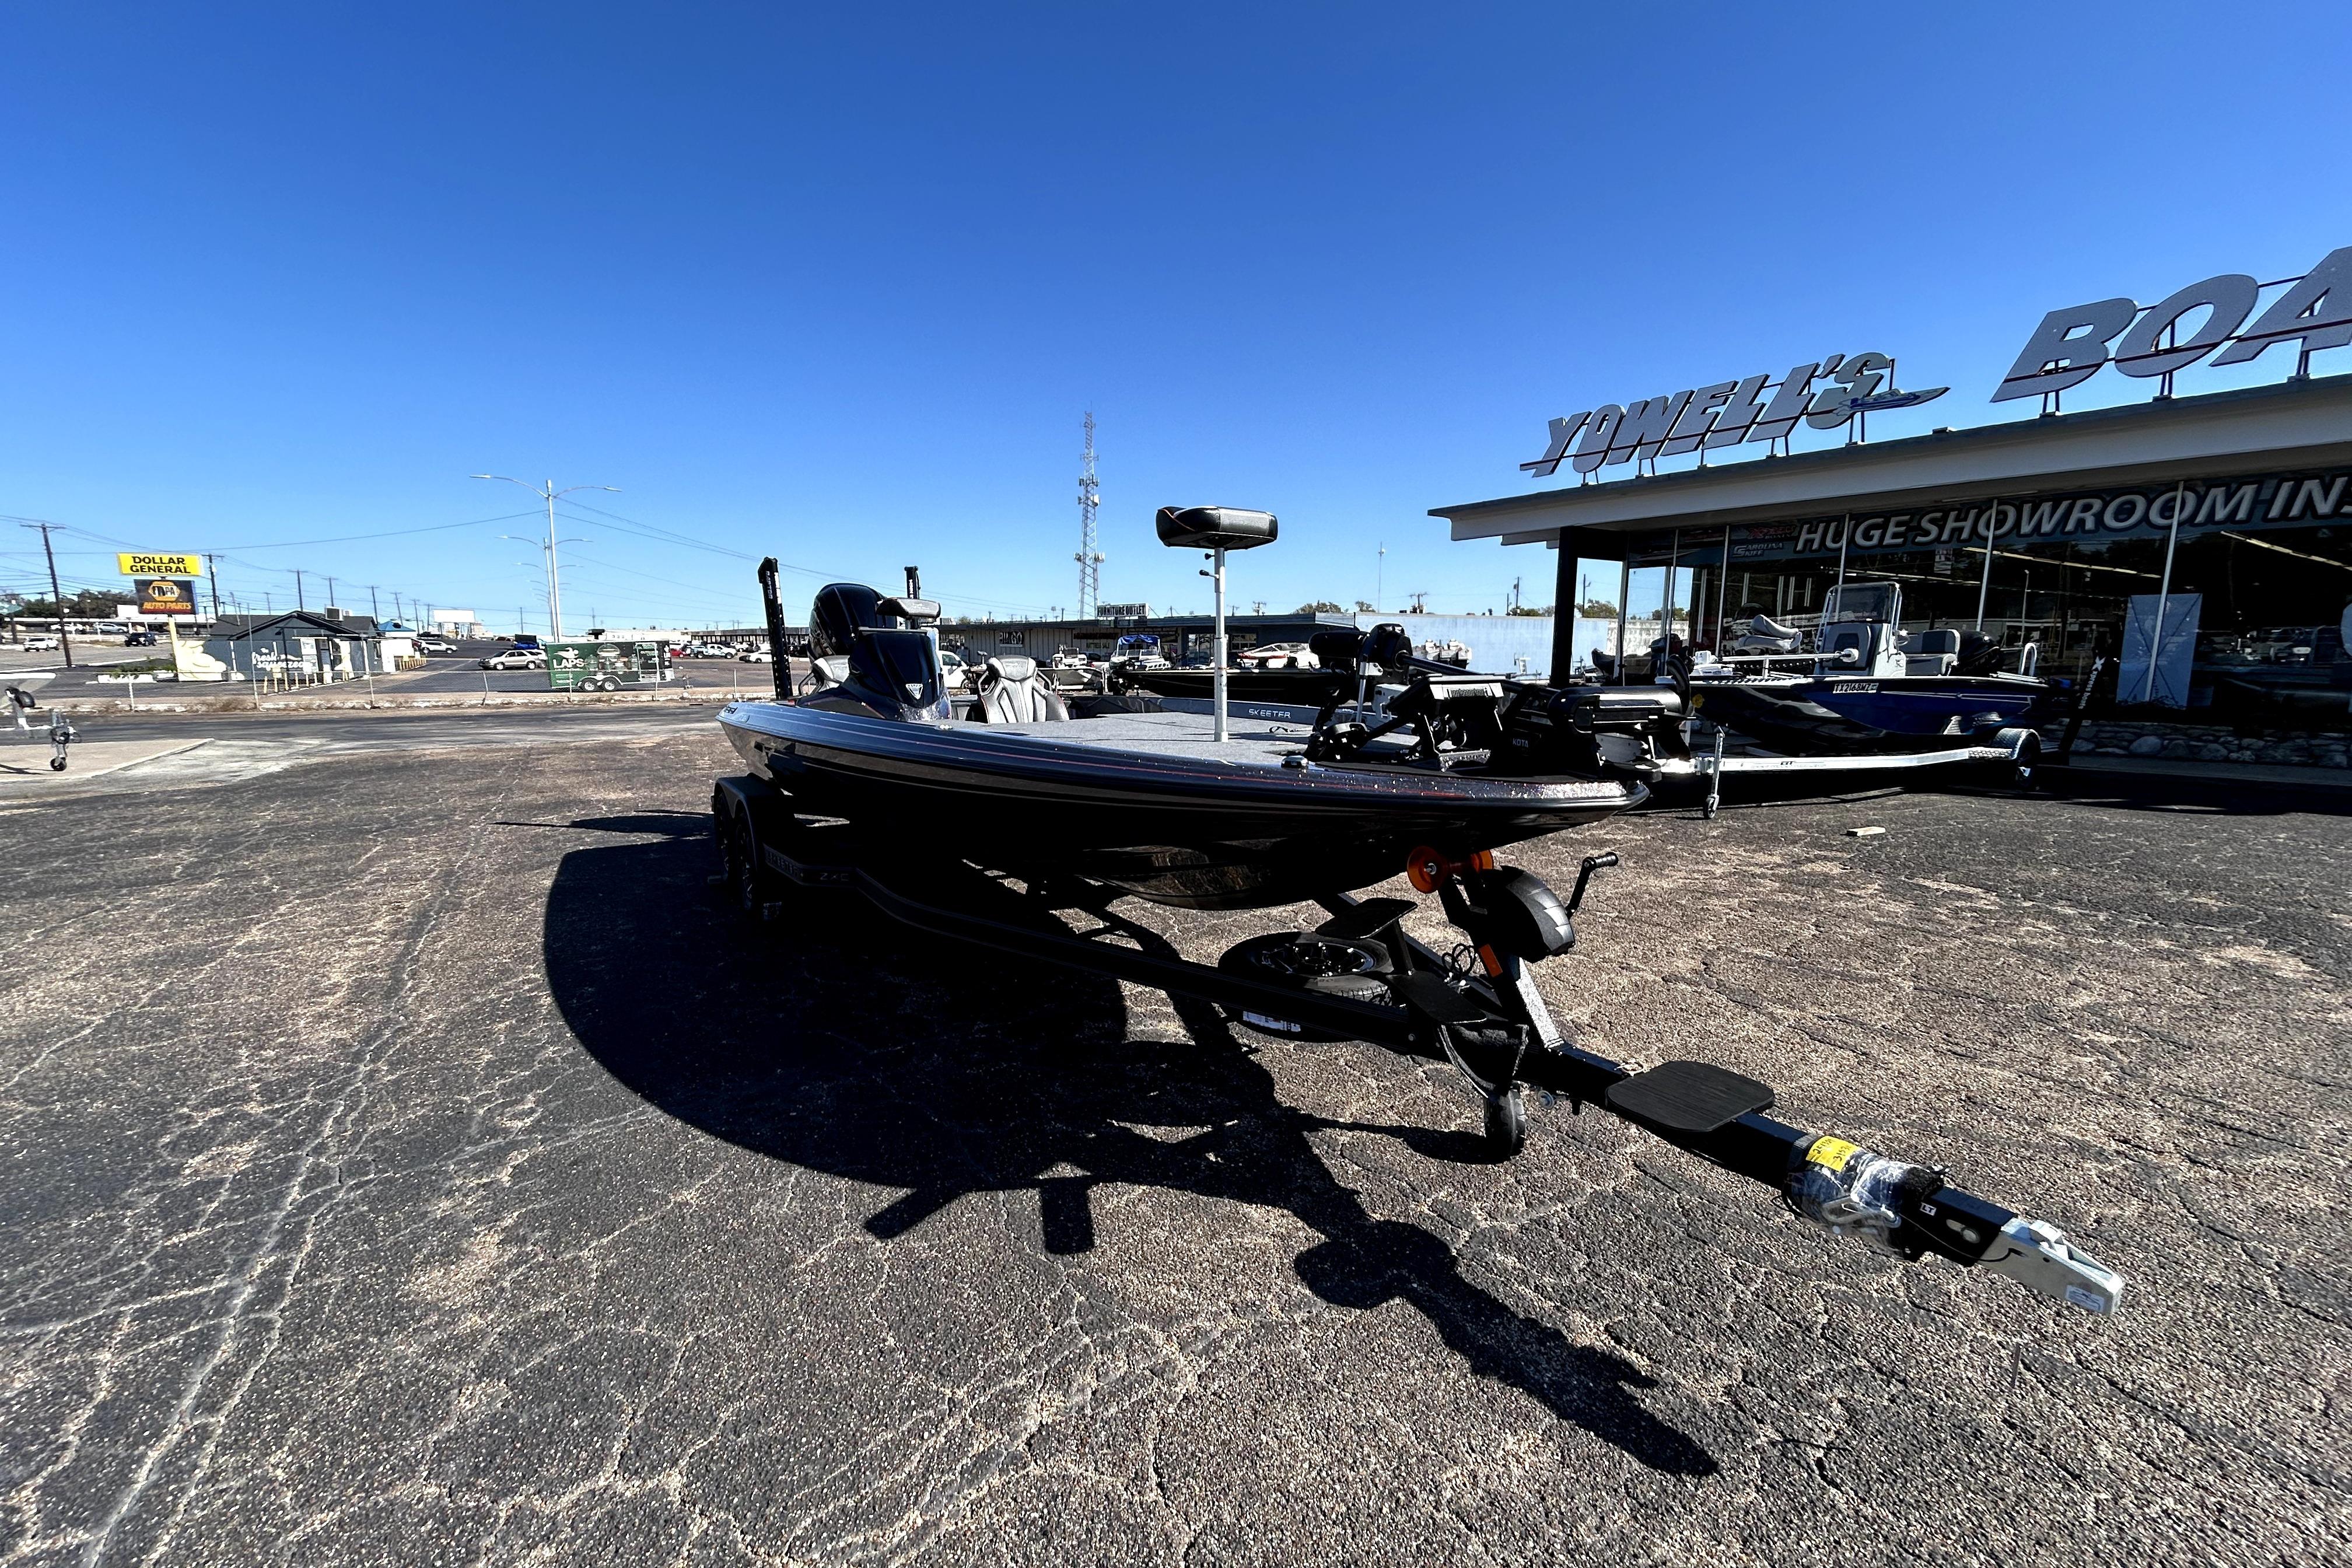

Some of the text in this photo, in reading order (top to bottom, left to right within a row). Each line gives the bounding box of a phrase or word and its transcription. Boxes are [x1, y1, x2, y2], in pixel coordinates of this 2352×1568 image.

[1528, 352, 1891, 477] YOWELL'S
[1796, 477, 2352, 551] HUGE SHOWROOM IN
[131, 556, 186, 565] DOLLAR
[130, 565, 191, 573] GENERAL
[1097, 605, 1144, 615] FURNITURE OUTLET
[553, 659, 584, 668] LAPS
[1248, 708, 1292, 719] SKEETER
[1513, 737, 1529, 748] KOTA
